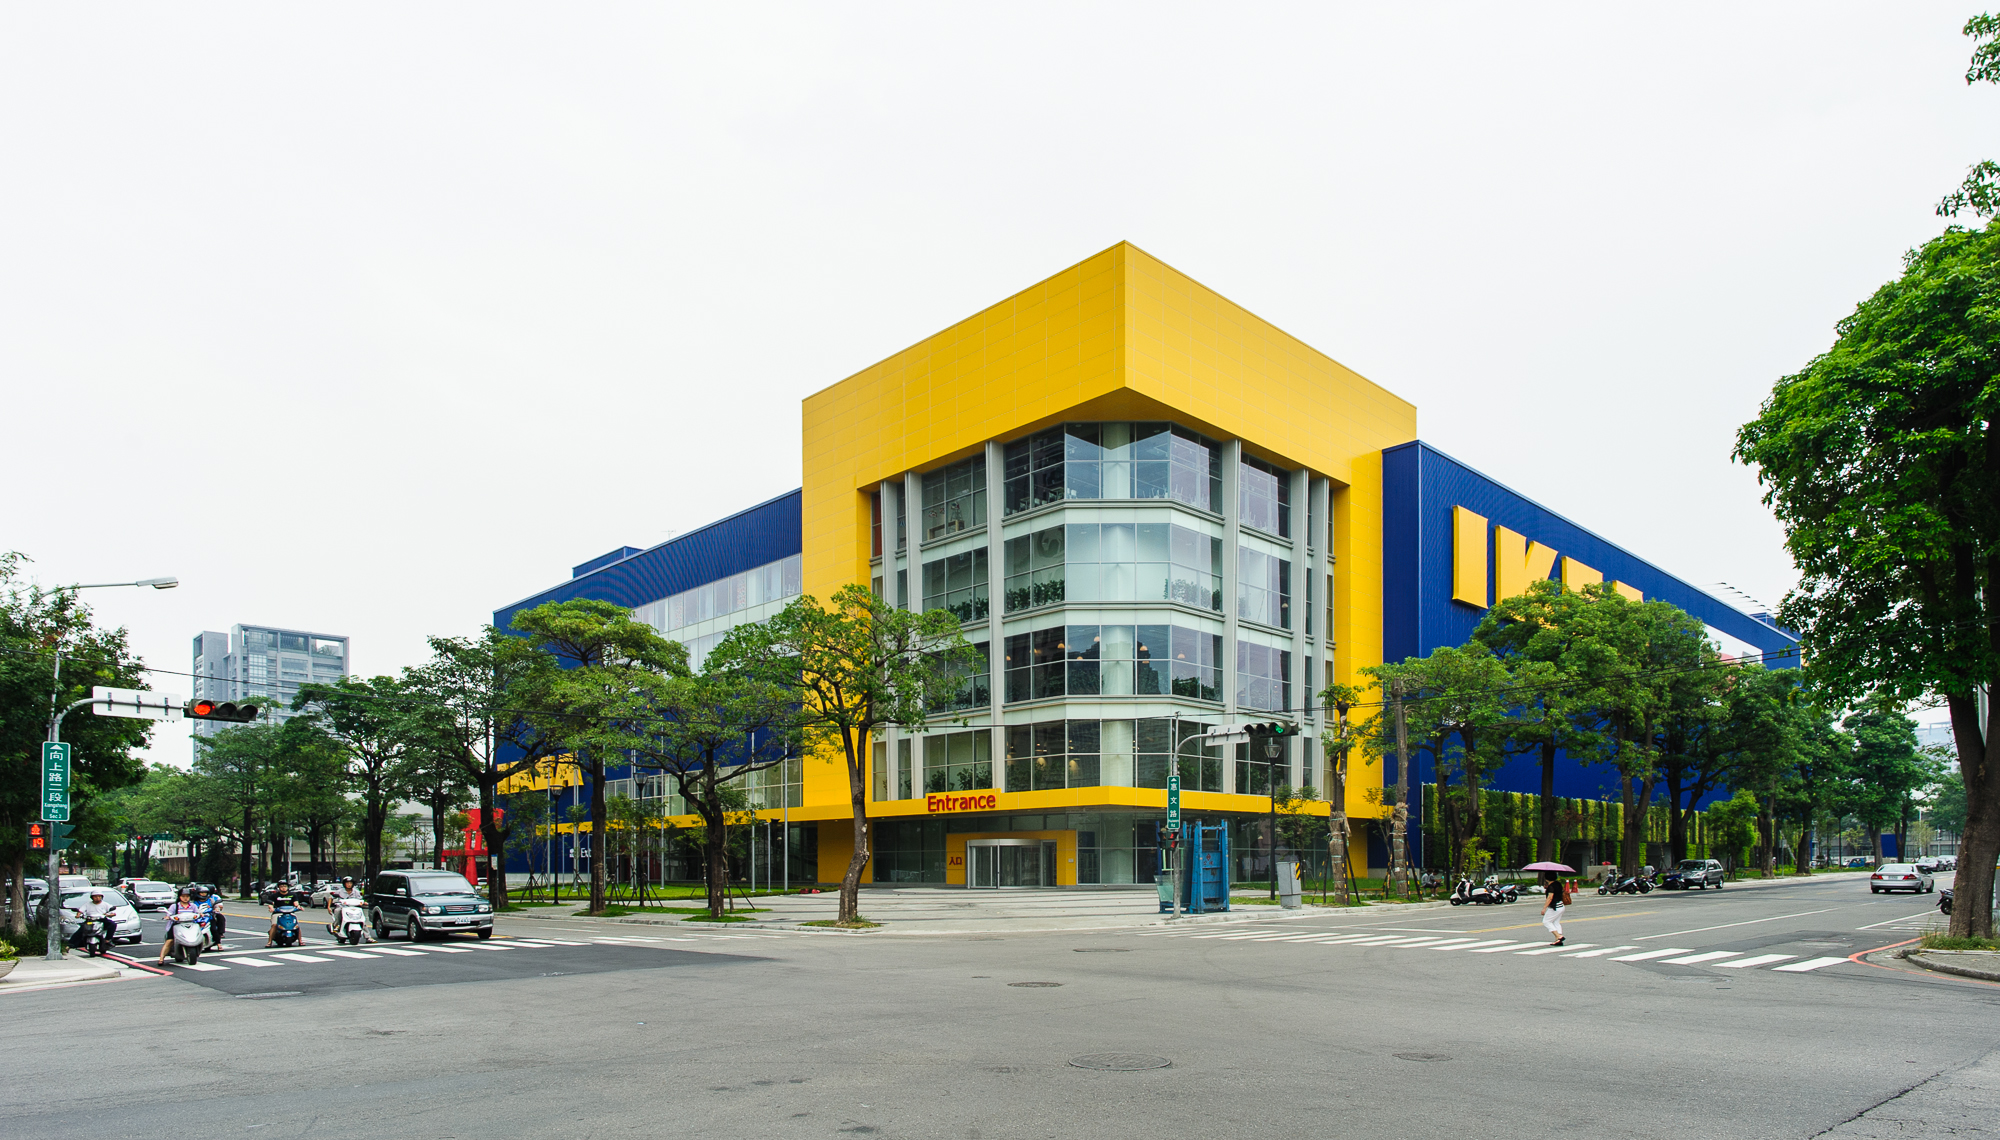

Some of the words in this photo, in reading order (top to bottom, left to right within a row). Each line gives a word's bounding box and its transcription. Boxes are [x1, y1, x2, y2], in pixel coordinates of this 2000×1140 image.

[48, 751, 64, 802] 向上路二段
[927, 794, 997, 812] Entrance
[32, 837, 45, 848] 19
[948, 856, 963, 866] 入口
